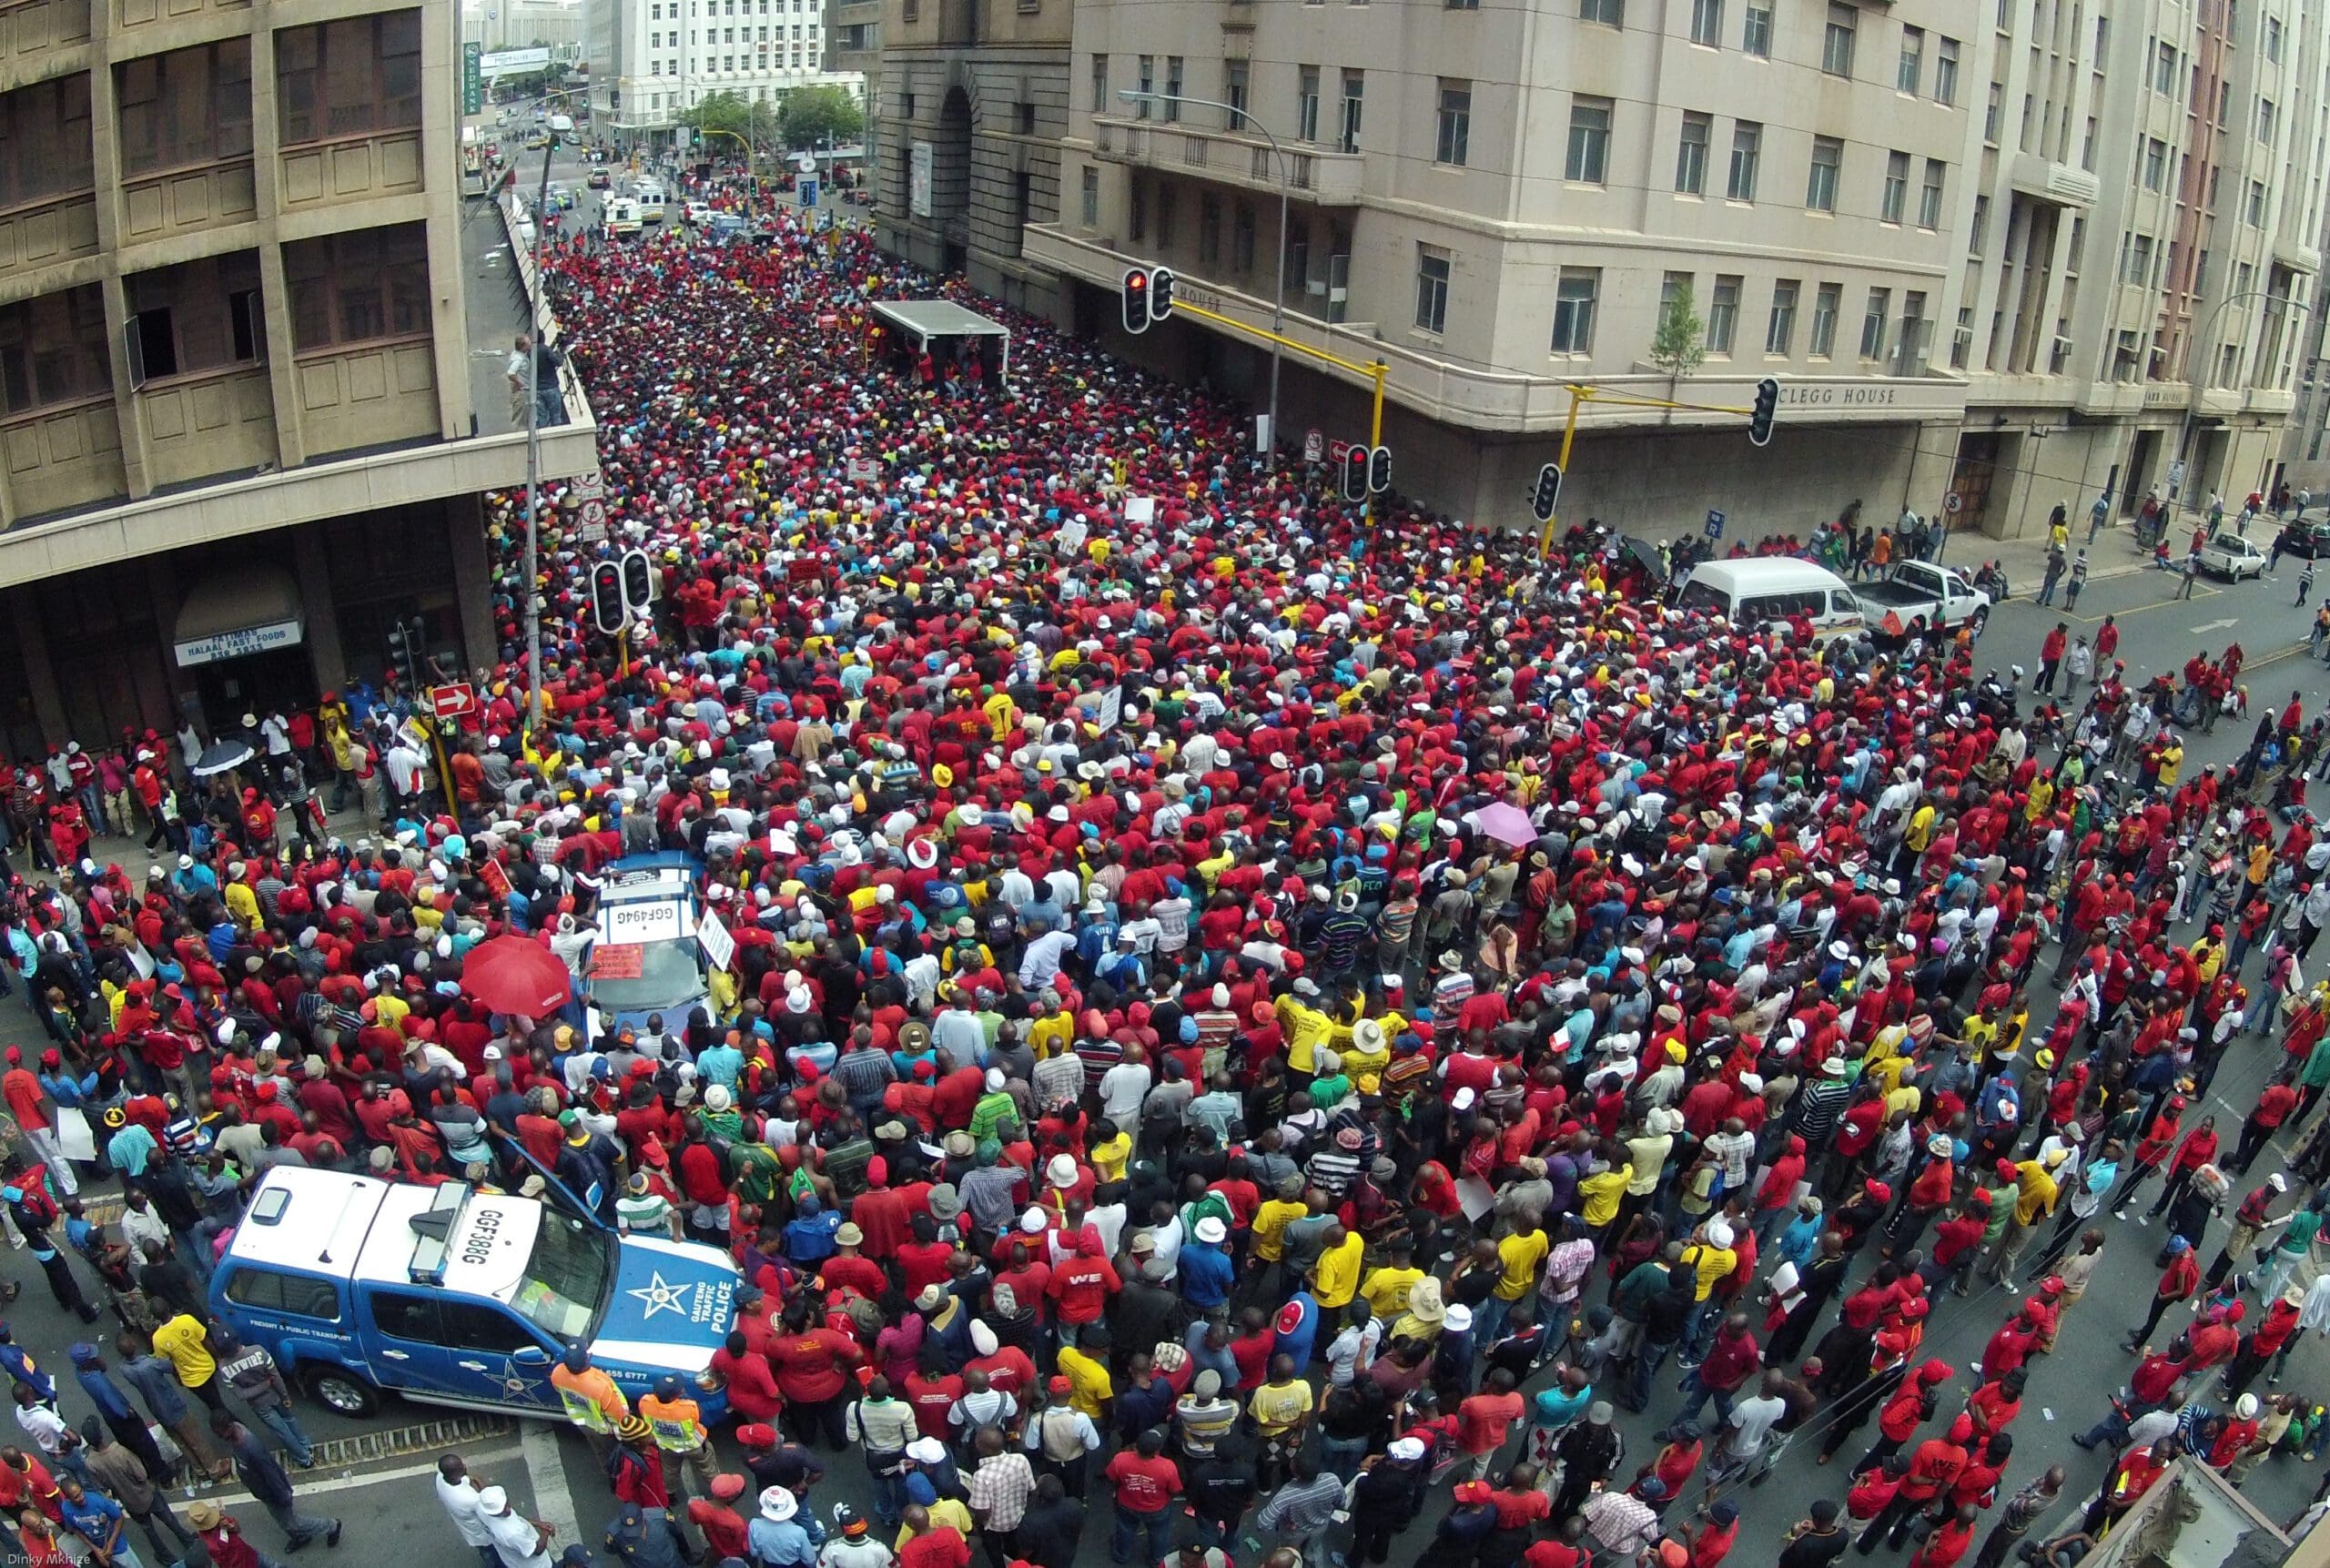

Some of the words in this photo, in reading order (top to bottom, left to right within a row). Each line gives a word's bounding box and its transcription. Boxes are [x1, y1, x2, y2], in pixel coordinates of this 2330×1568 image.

[468, 58, 476, 113] NEDBANK
[1180, 286, 1221, 313] HOUSE
[1778, 389, 1832, 403] CLEGG
[1844, 389, 1895, 403] HOUSE
[187, 642, 222, 656] HALAAL
[228, 637, 250, 649] FAST
[257, 631, 286, 642] FOODS
[617, 907, 674, 925] GGF494G
[461, 1209, 503, 1265] GGF388G
[1069, 1273, 1102, 1285] WE
[691, 1281, 706, 1322] GAUTENG
[701, 1285, 715, 1322] TRAFFIC
[711, 1280, 732, 1334] POLICE
[249, 1320, 278, 1330] FREIGHT
[286, 1325, 311, 1336] PUBLIC
[311, 1330, 352, 1342] TRANSPORT
[624, 1371, 647, 1381] 6777
